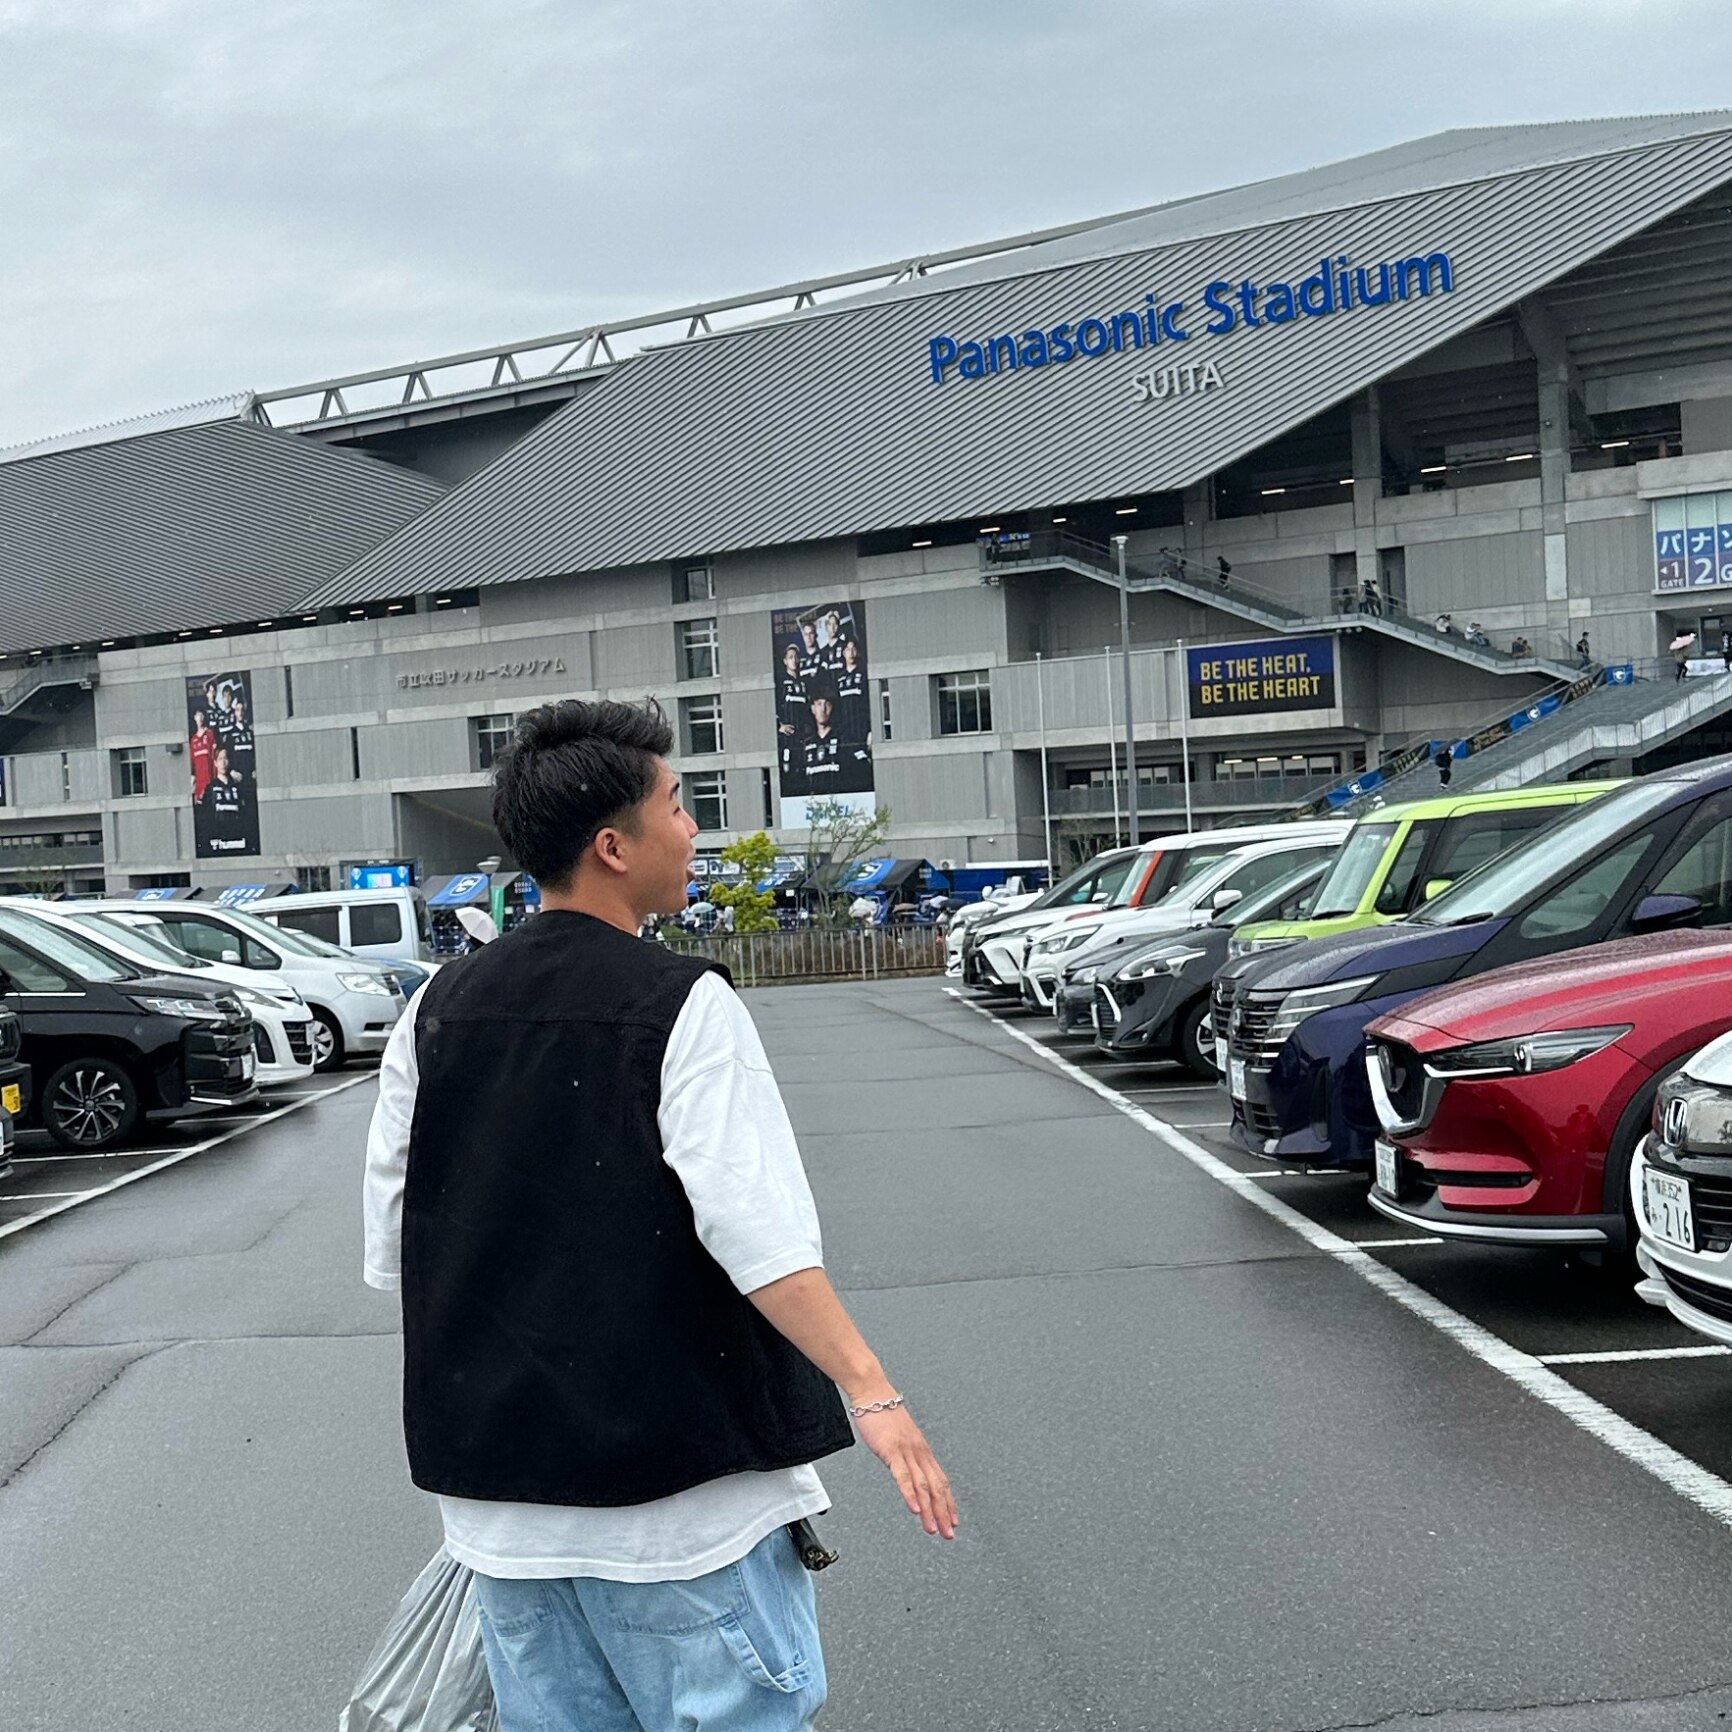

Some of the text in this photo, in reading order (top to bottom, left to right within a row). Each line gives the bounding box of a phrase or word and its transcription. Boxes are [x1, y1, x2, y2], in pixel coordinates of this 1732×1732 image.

[929, 251, 1453, 384] Panasonic Stadium
[1132, 361, 1225, 401] SUITA
[1660, 578, 1684, 588] GATE
[1671, 561, 1680, 578] 1
[1694, 557, 1713, 585] 2
[1200, 653, 1312, 681] BE THE HEAT,
[1201, 676, 1321, 704] BE THE HEART
